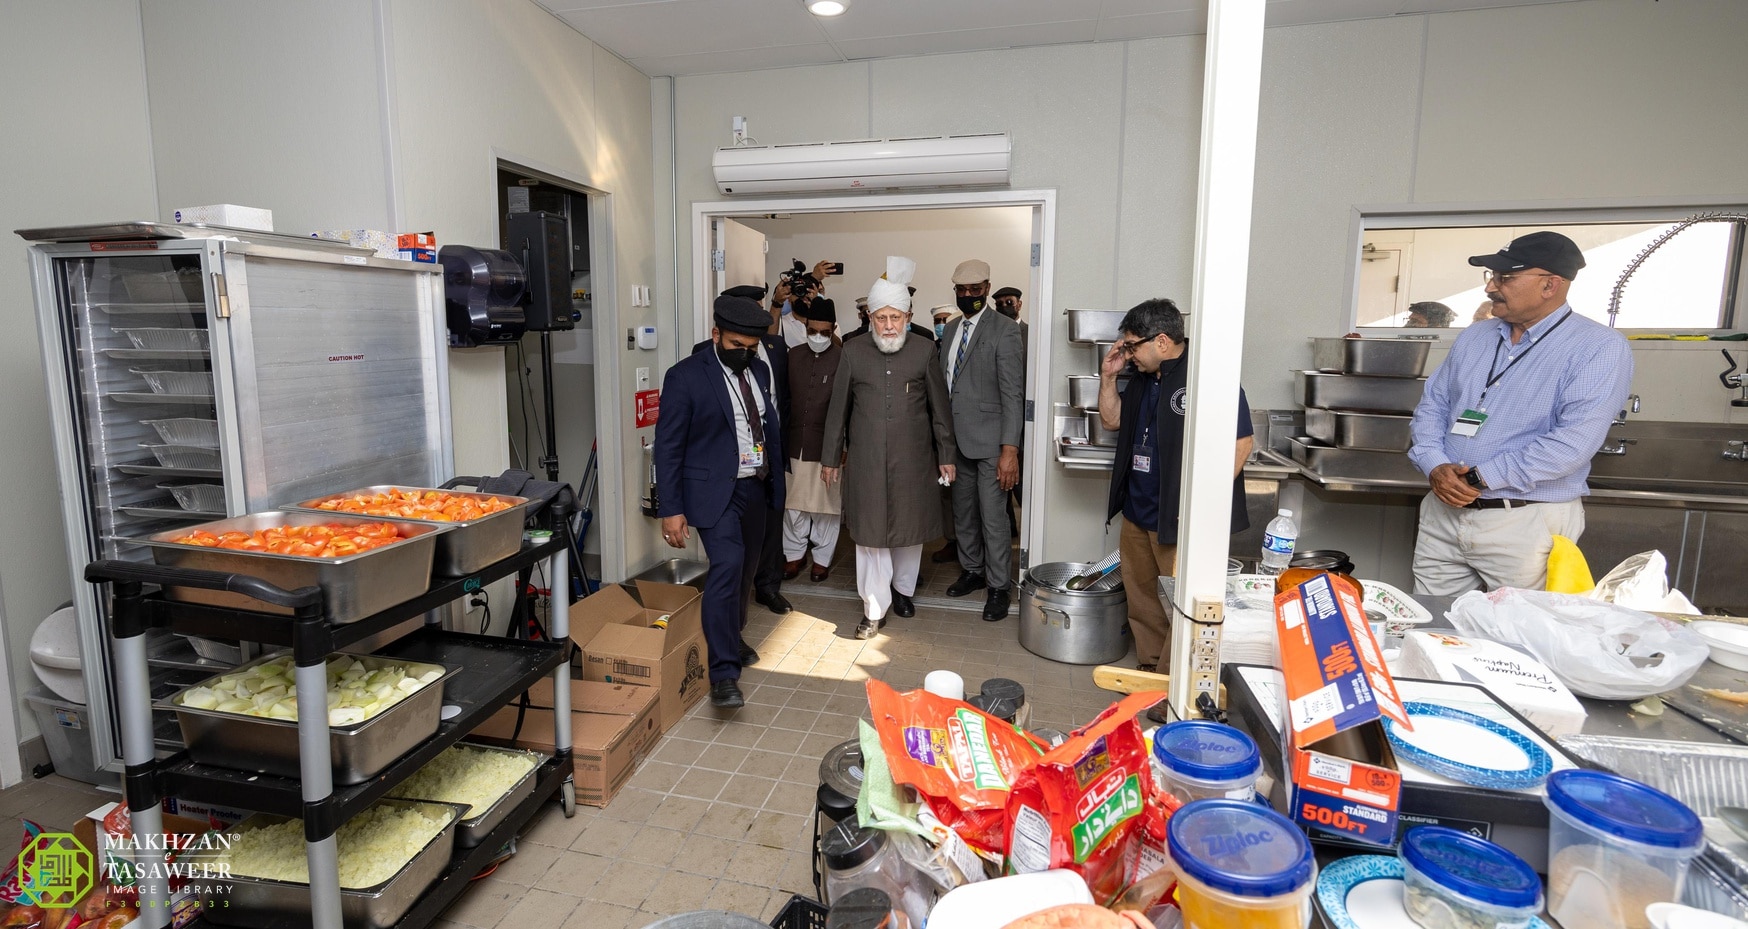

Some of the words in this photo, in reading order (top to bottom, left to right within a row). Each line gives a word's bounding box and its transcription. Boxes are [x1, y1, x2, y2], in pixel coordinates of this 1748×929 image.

[1473, 656, 1521, 671] Napkins
[1485, 665, 1553, 685] Premium
[951, 720, 974, 778] TAPAL
[962, 710, 1008, 789] DANEDAR
[180, 803, 209, 815] Heater
[210, 807, 242, 820] Proofer
[1342, 805, 1389, 824] STANDARD
[1398, 814, 1439, 825] CLASSIFIER
[1201, 830, 1274, 857] Ziploc
[1143, 847, 1165, 865] ASALA
